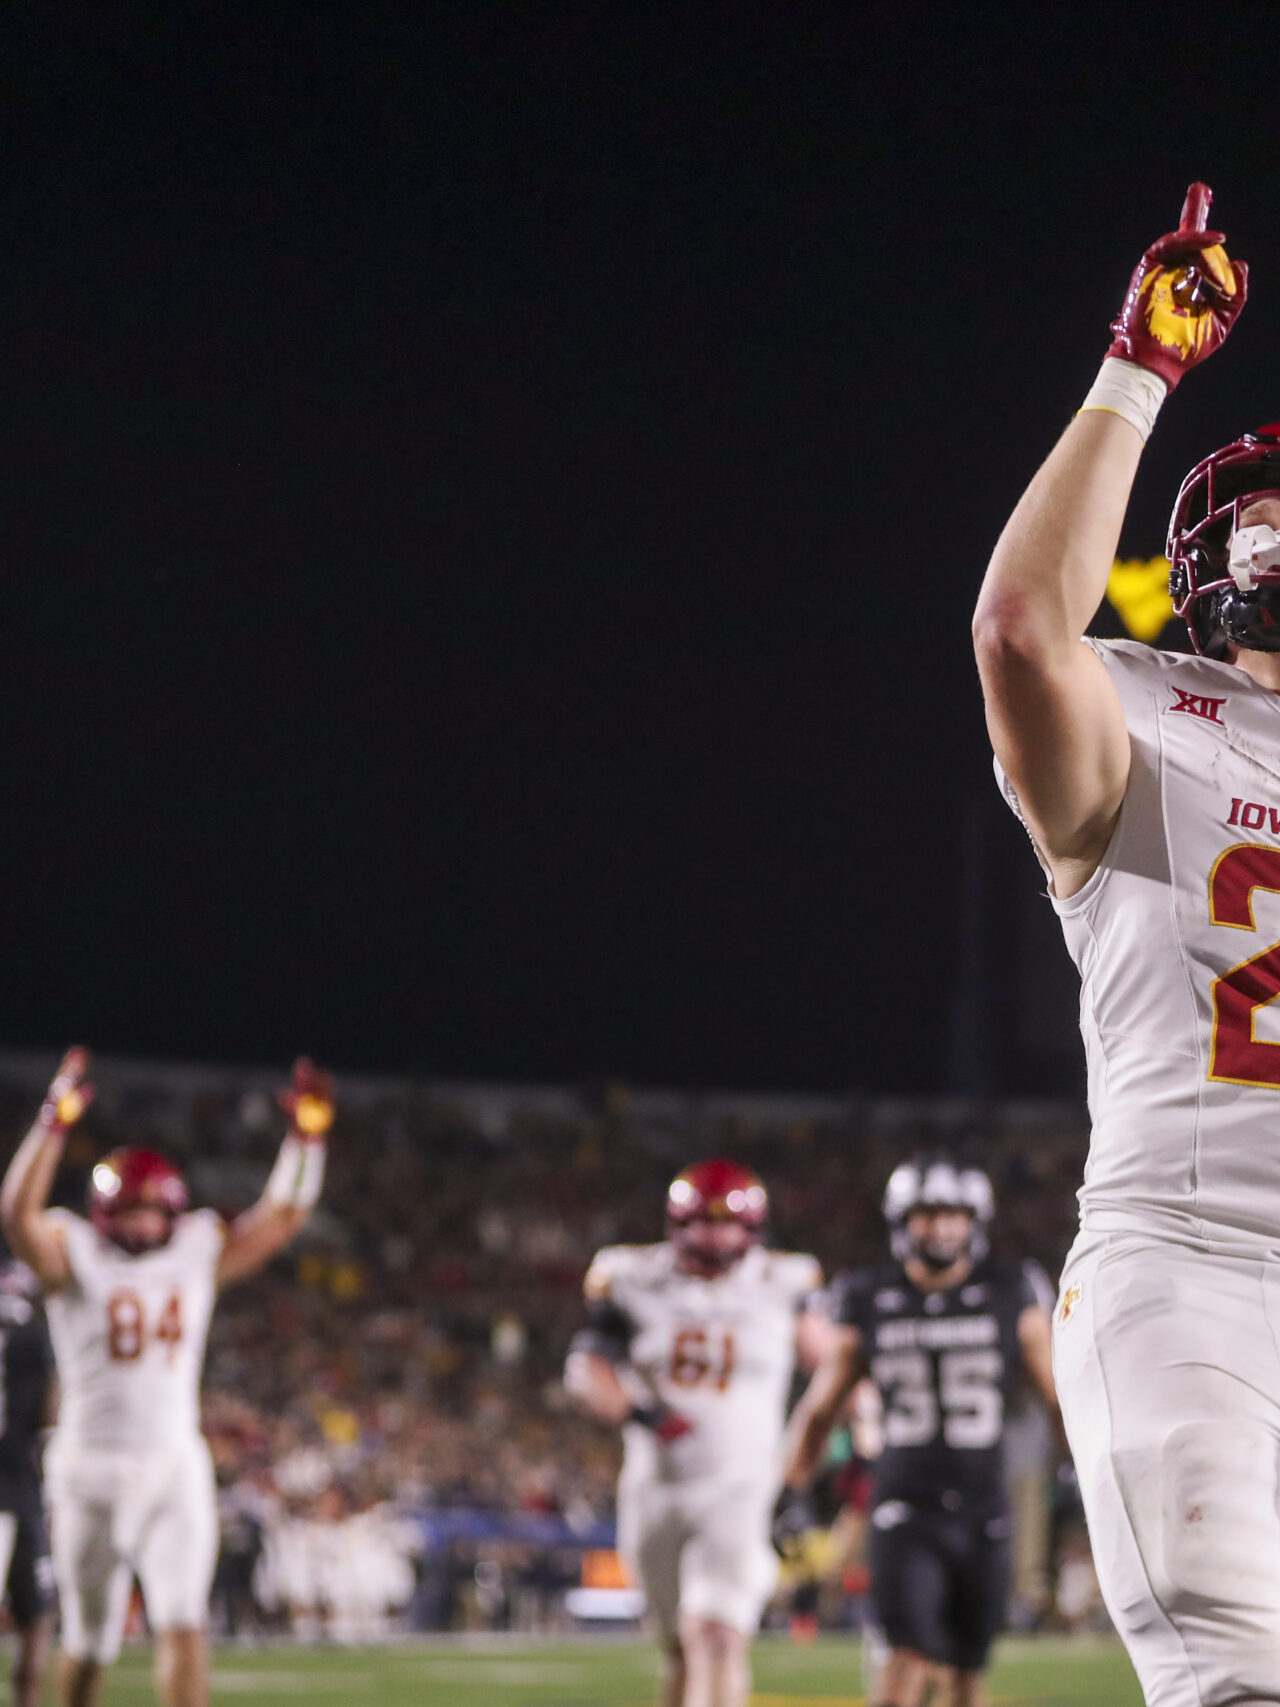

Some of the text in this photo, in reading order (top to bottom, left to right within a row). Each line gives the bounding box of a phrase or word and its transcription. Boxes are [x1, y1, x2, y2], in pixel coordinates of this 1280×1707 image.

[107, 1289, 184, 1363] 84
[670, 1326, 736, 1396] 61
[870, 1348, 1005, 1450] 35
